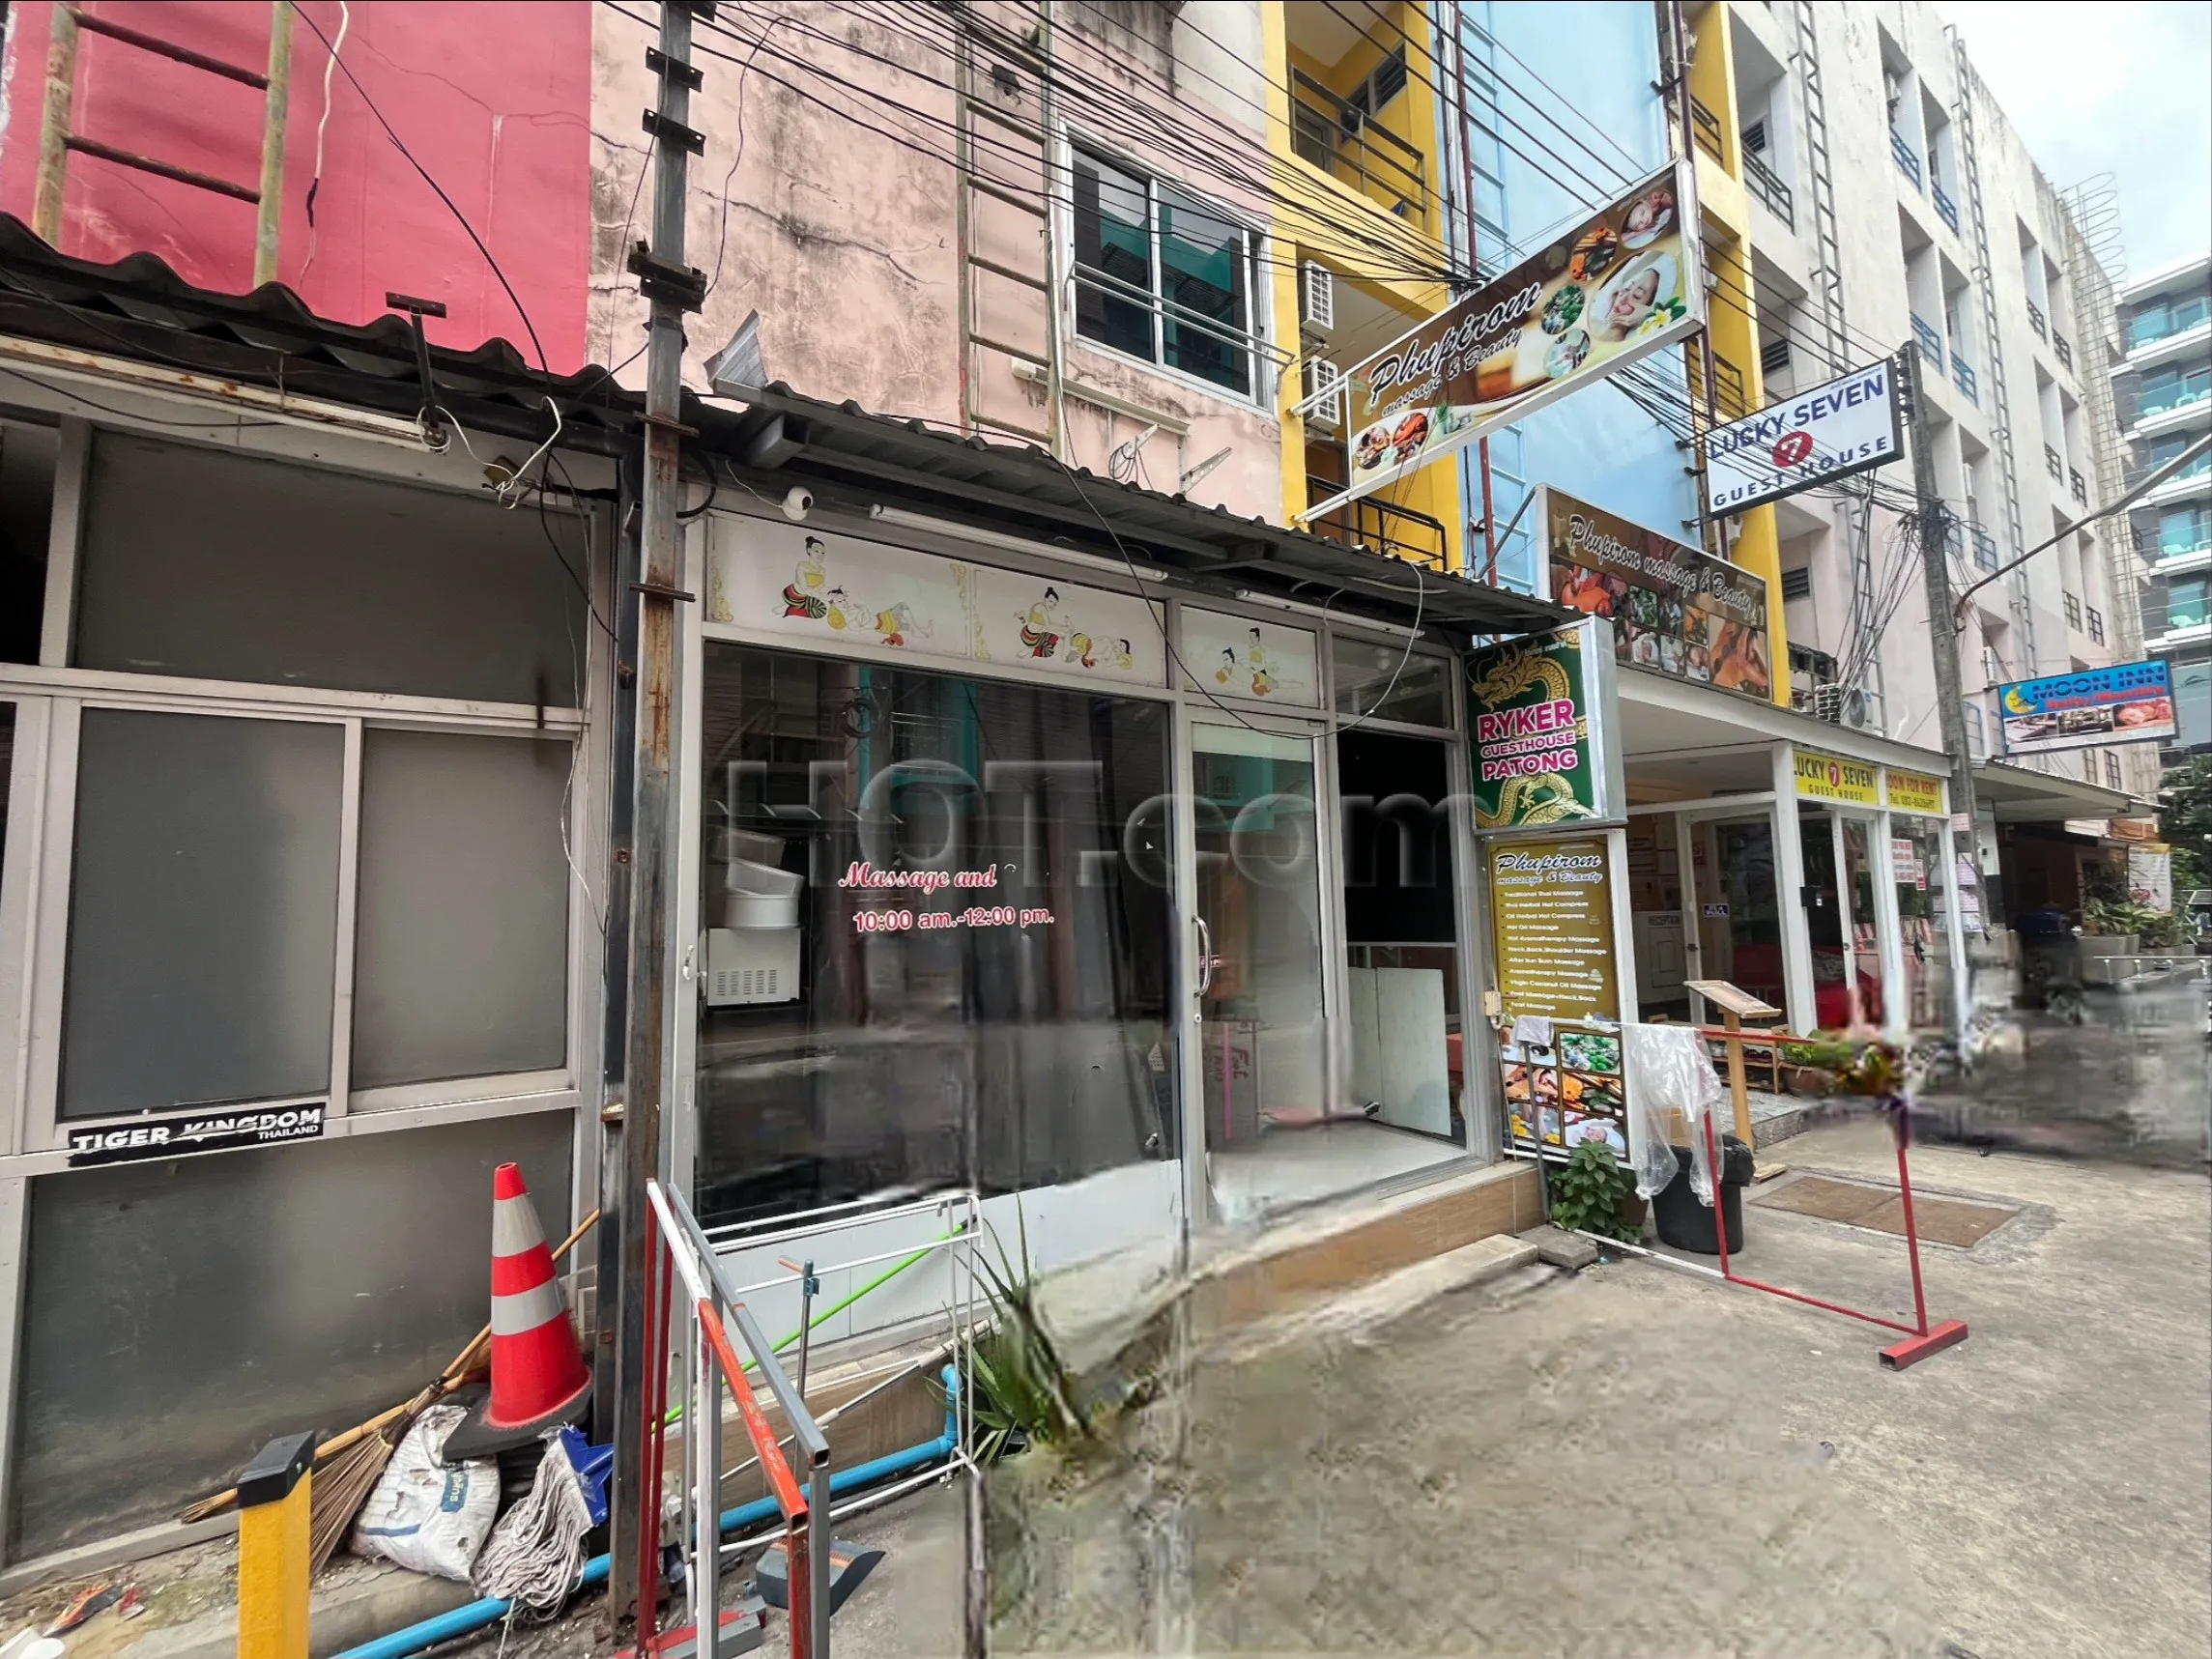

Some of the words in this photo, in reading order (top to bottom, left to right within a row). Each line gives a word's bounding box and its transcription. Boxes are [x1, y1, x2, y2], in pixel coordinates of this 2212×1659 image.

[1369, 282, 1542, 406] Phupirom
[1382, 375, 1442, 417] massage
[1448, 357, 1460, 380] &
[1464, 328, 1522, 371] Beauty
[1709, 412, 1786, 459] LUCKY
[1794, 374, 1883, 426] SEVEN
[1713, 472, 1784, 506] GUEST
[1799, 436, 1887, 478] HOUSE
[1569, 513, 1641, 570] Phupirom
[1644, 556, 1697, 597] massage
[1699, 566, 1710, 595] &
[1712, 571, 1752, 615] Beauty
[2032, 673, 2111, 701] MOON
[2118, 665, 2165, 687] INN
[1478, 698, 1576, 743] RYKER
[1480, 732, 1576, 758] GUESTHOUSE
[1481, 748, 1579, 782] PATONG
[1843, 765, 1874, 788] SEVEN
[1808, 784, 1834, 797] GUEST
[1838, 788, 1863, 801] HOUSE
[838, 861, 950, 895] Massage
[953, 863, 998, 888] and
[1496, 851, 1602, 874] Phupirom
[1497, 874, 1543, 886] massage
[1546, 872, 1557, 882] &
[1559, 871, 1603, 883] Beauty
[853, 909, 913, 932] 10:00
[1020, 907, 1055, 928] pm.
[1526, 1002, 1557, 1011] Massage
[72, 1127, 170, 1152] TIGER
[179, 1108, 321, 1136] KINGDOM
[257, 1126, 319, 1141] THAILAND
